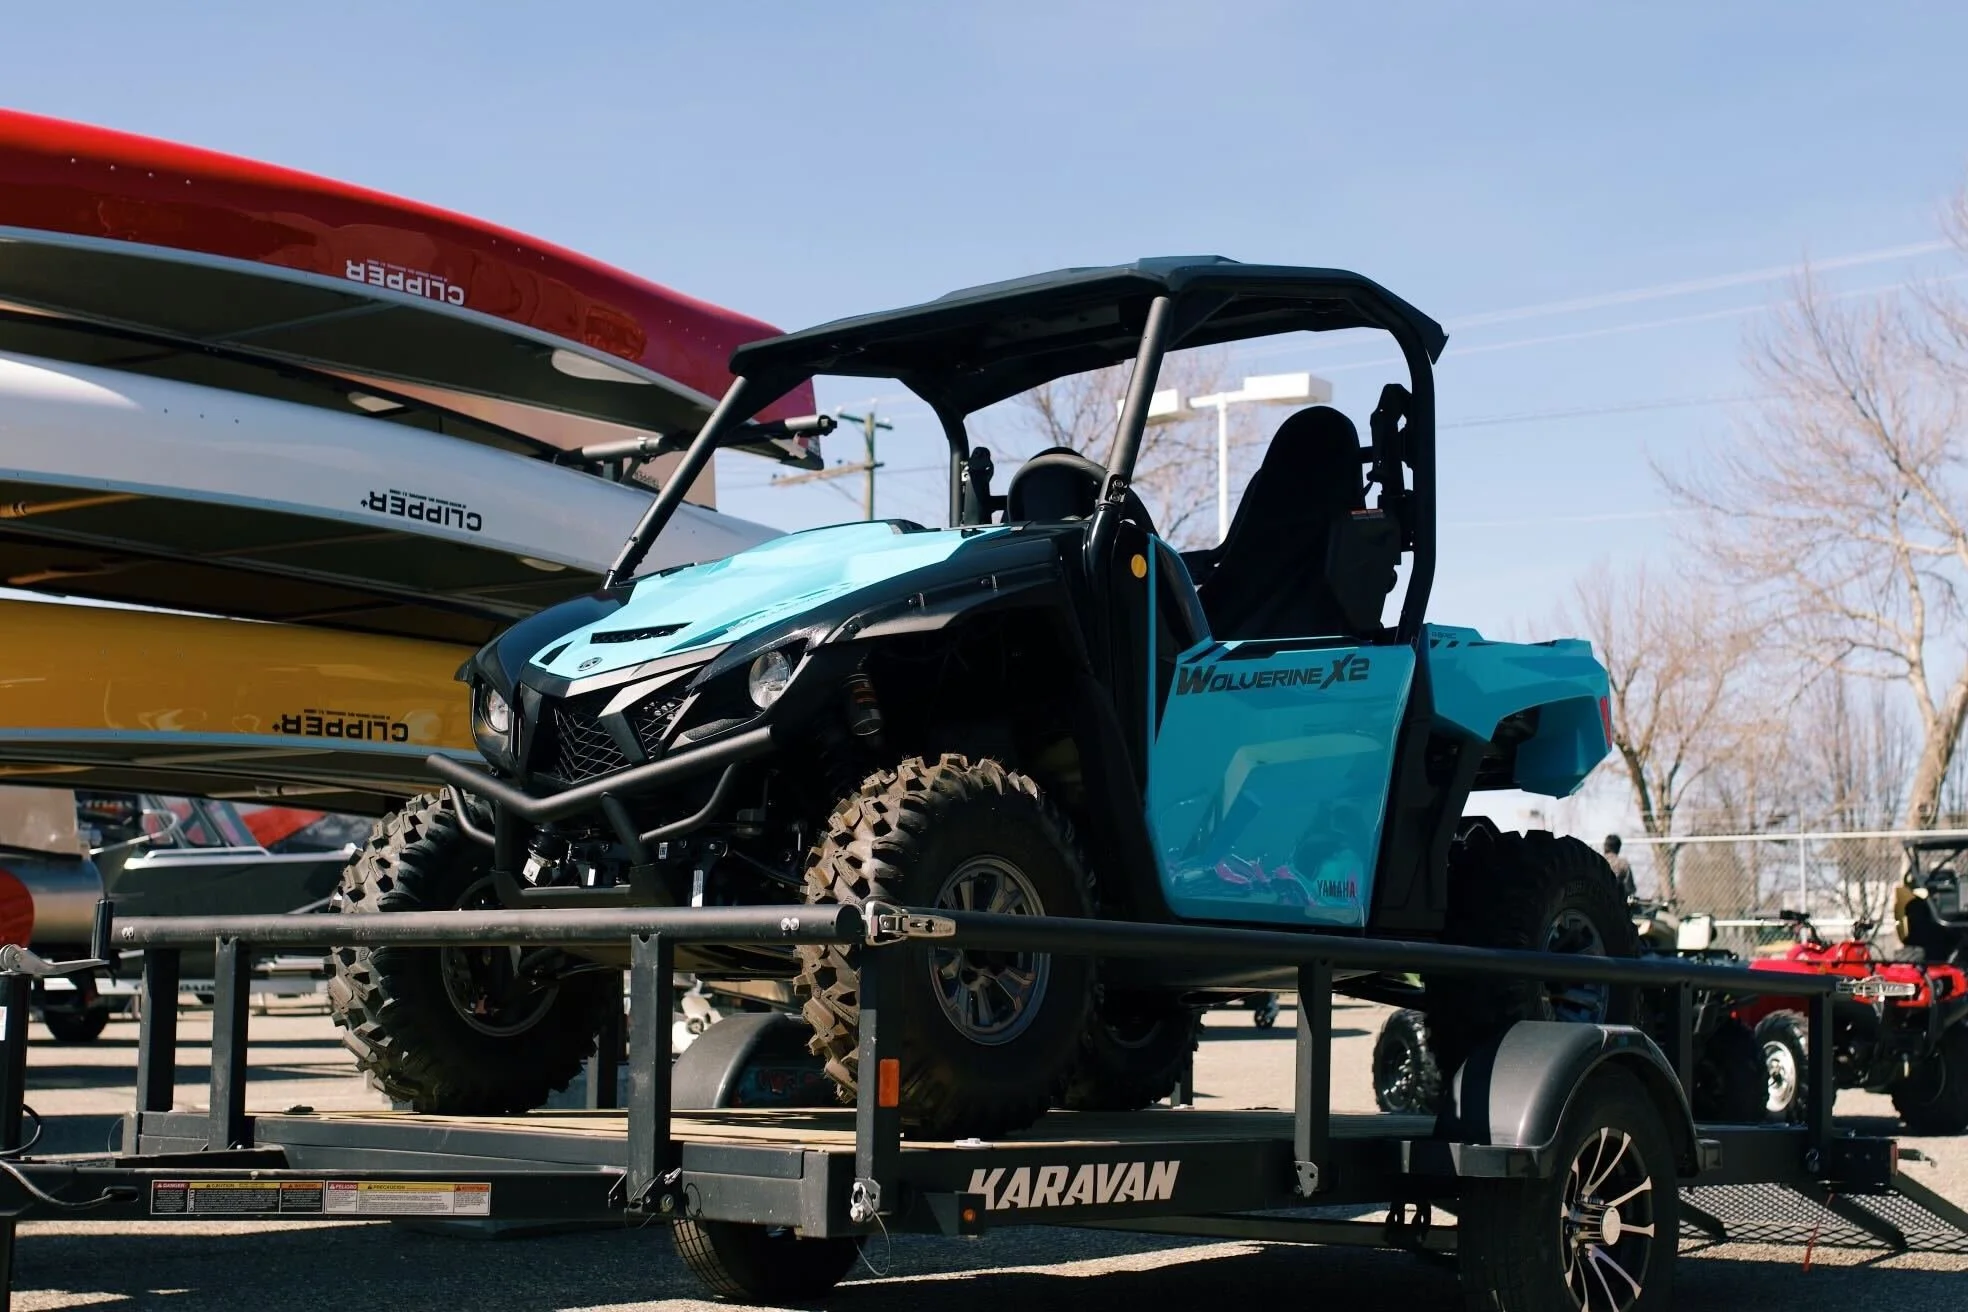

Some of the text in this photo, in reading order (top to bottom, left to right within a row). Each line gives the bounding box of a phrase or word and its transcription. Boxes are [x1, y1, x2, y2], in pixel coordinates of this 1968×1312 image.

[345, 259, 465, 306] CLIPPER
[369, 490, 482, 532] CLIPPER
[1320, 653, 1371, 690] X2
[281, 714, 408, 743] CLIPPER
[1317, 879, 1356, 898] YAMAHA
[967, 1160, 1181, 1210] KARAVAN
